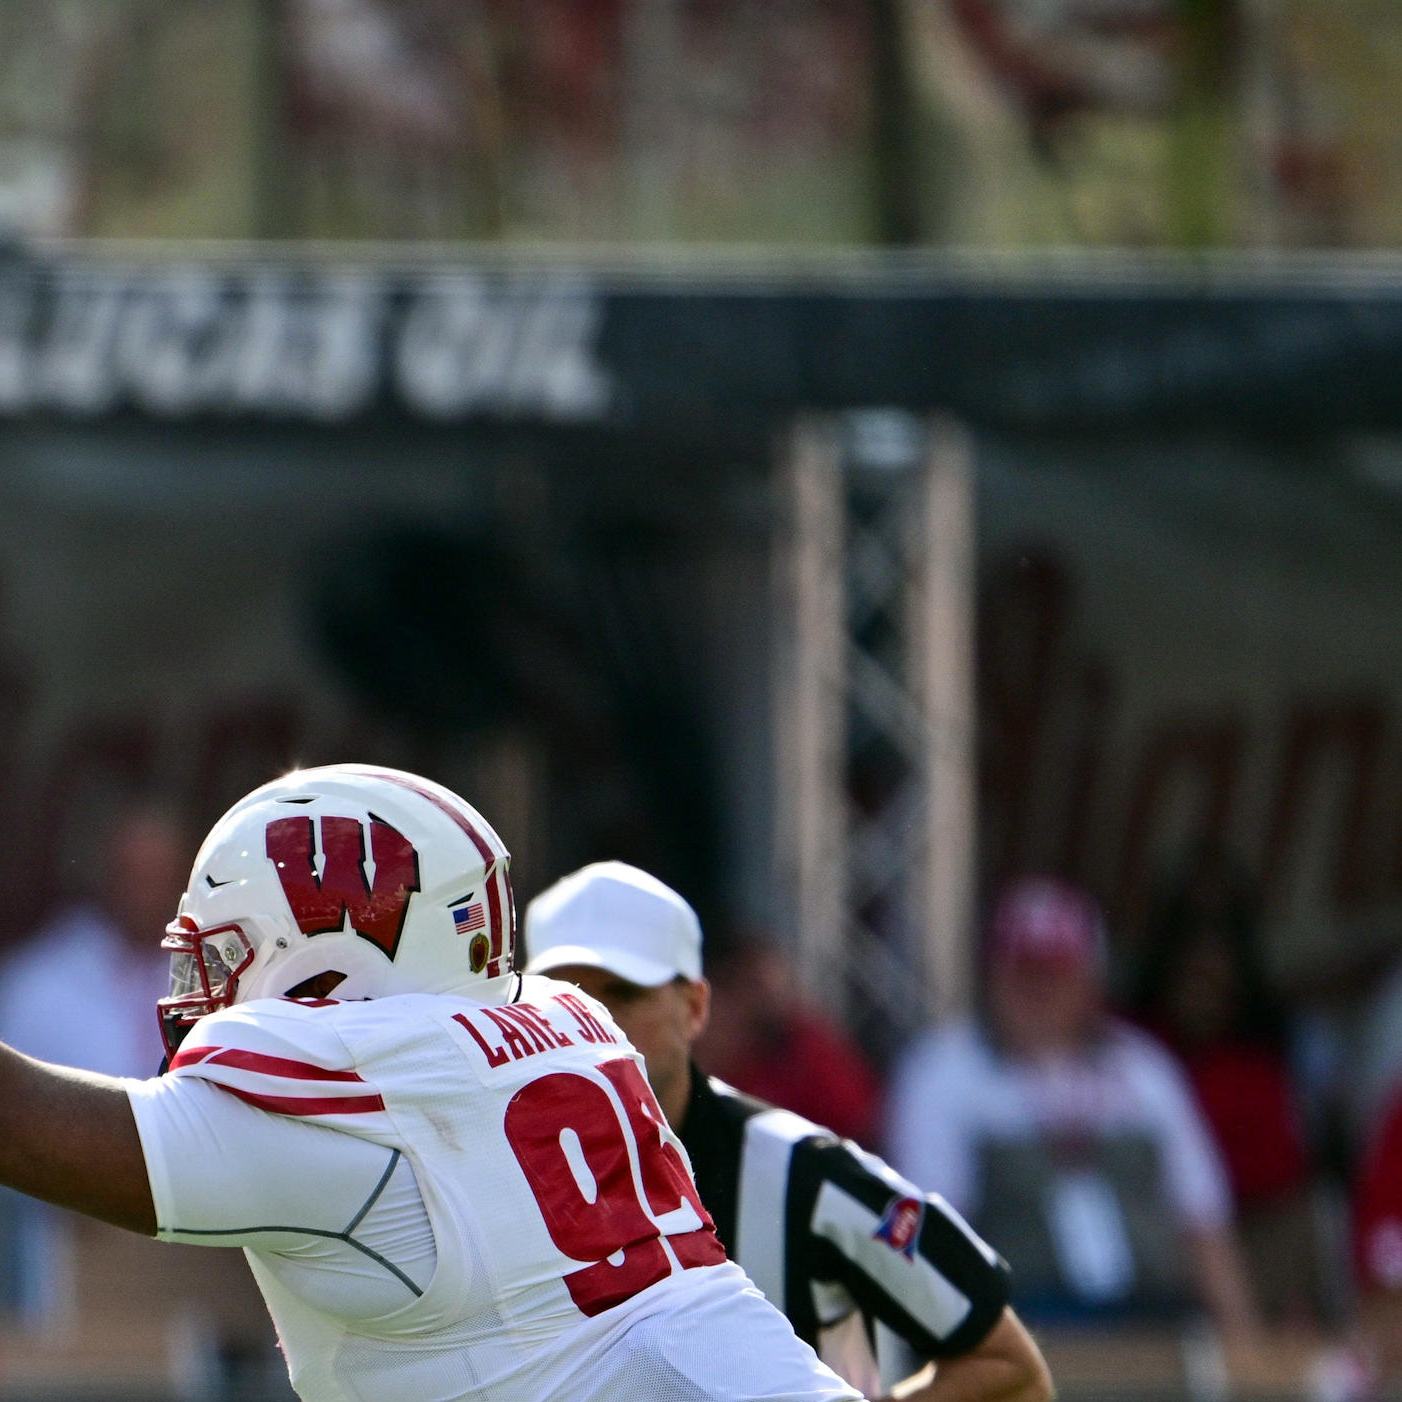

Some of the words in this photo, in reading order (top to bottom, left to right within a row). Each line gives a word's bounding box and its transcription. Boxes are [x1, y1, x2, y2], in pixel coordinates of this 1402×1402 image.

[397, 268, 614, 420] OIL
[265, 816, 421, 963] W
[451, 1003, 575, 1069] LANE
